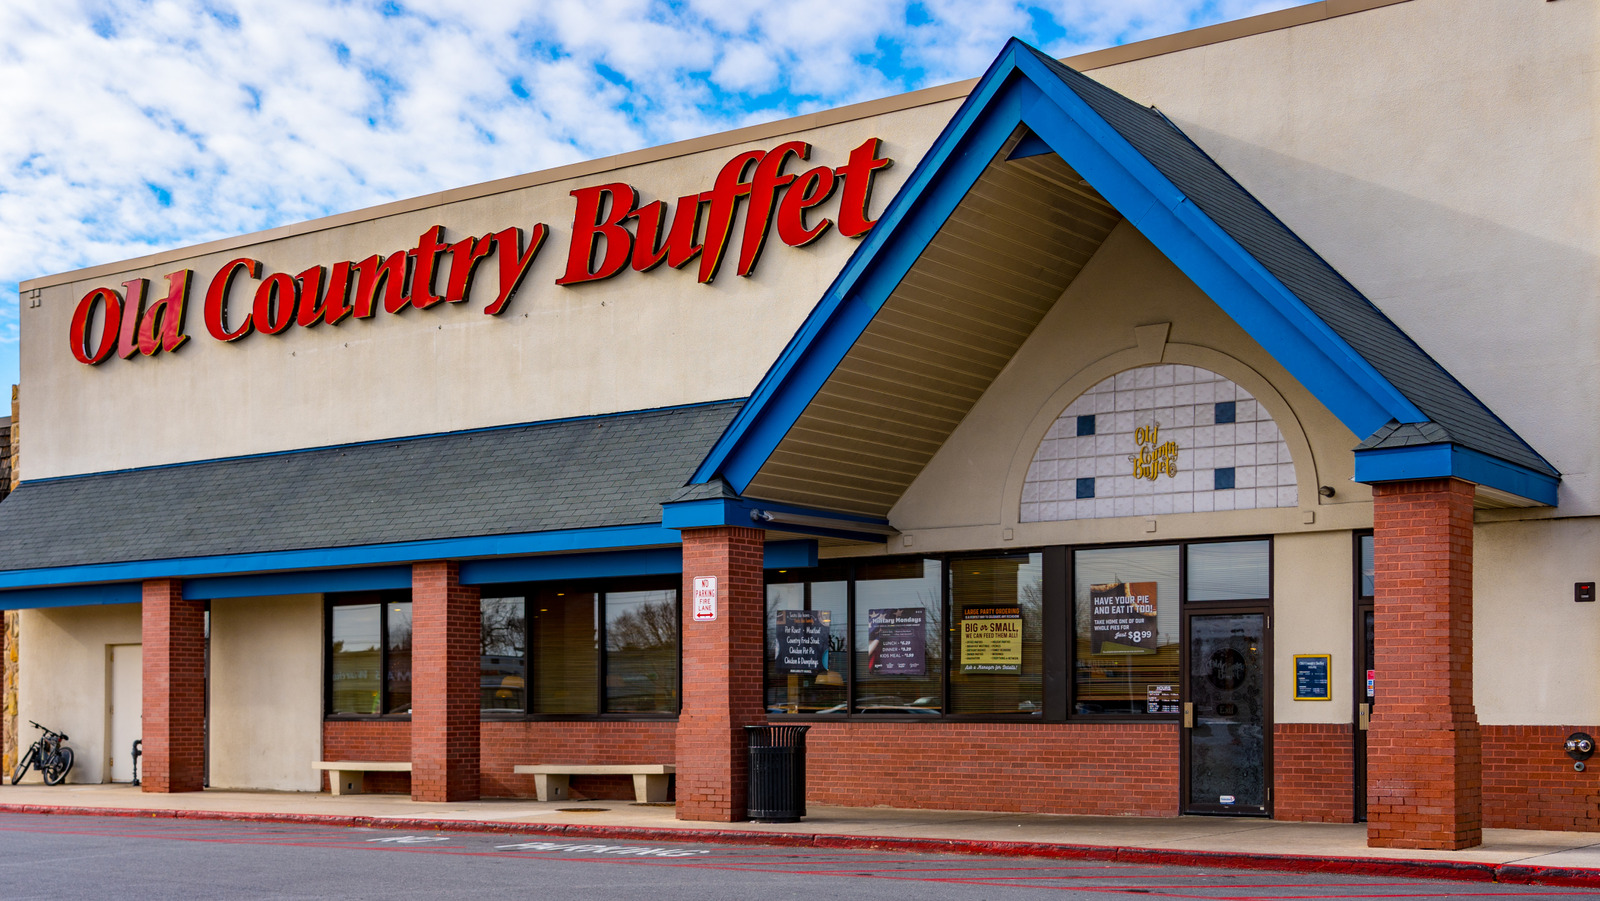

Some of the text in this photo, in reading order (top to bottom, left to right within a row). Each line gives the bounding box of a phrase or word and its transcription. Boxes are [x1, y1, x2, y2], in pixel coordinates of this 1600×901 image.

[70, 137, 894, 365] Old Country Buffet
[1135, 421, 1160, 447] Old
[701, 579, 709, 588] NO
[695, 589, 715, 598] PARKING
[1094, 595, 1150, 605] HAVE YOUR PIE
[995, 607, 1020, 615] ORDERING
[1094, 604, 1153, 615] AND EAT IT TOO!
[872, 616, 922, 625] Military Mondays
[965, 623, 978, 632] BIG
[786, 636, 800, 646] Country
[493, 841, 710, 858] PARKING
